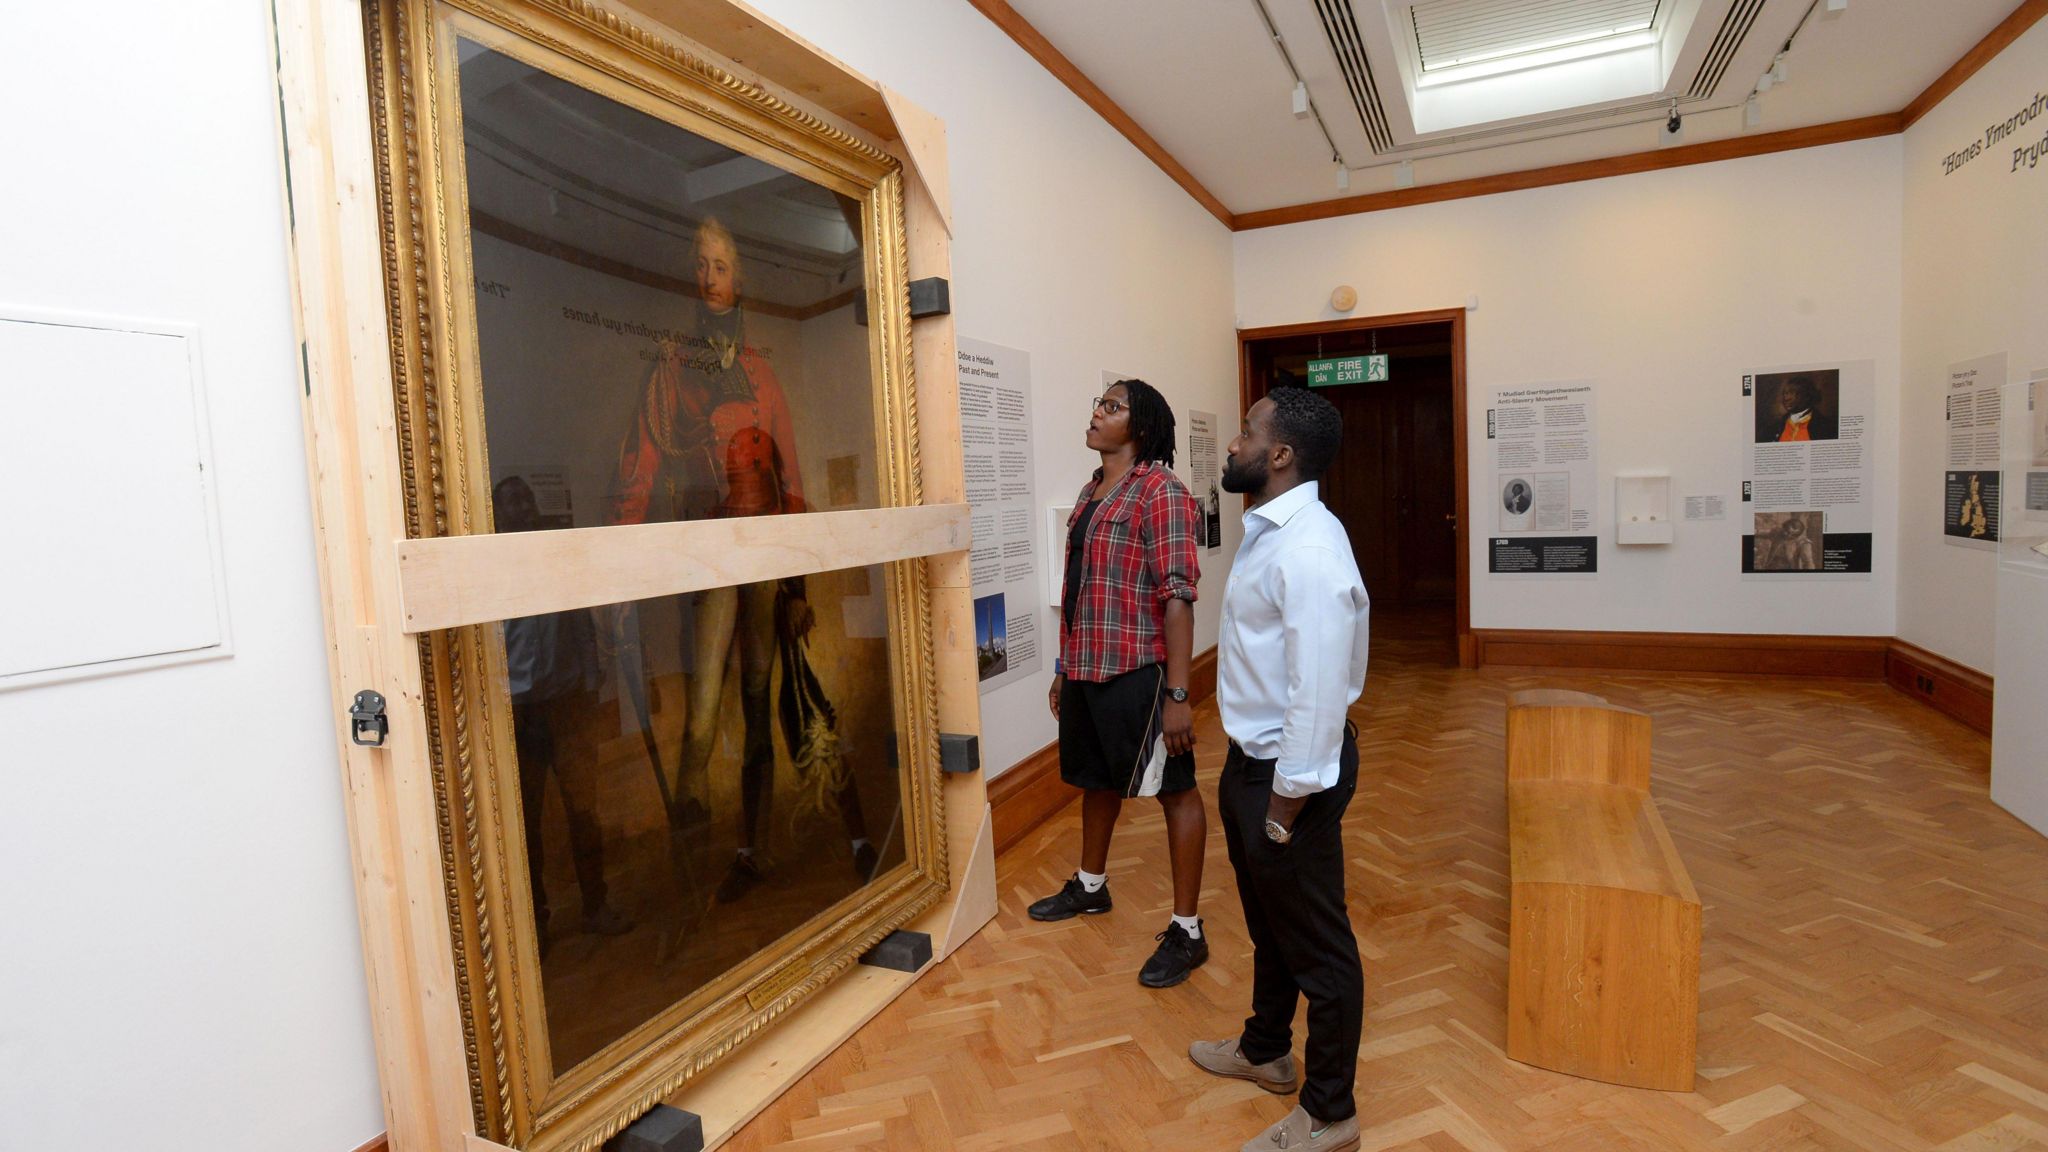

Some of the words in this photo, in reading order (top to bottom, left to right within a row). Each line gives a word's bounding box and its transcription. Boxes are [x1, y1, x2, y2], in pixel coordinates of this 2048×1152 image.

[1985, 92, 2048, 149] Ymerodr
[1308, 362, 1333, 372] ALLANFA
[1337, 360, 1362, 370] FIRE
[959, 364, 970, 374] Past
[971, 368, 980, 376] and
[981, 368, 999, 379] Present
[1337, 370, 1362, 380] EXIT
